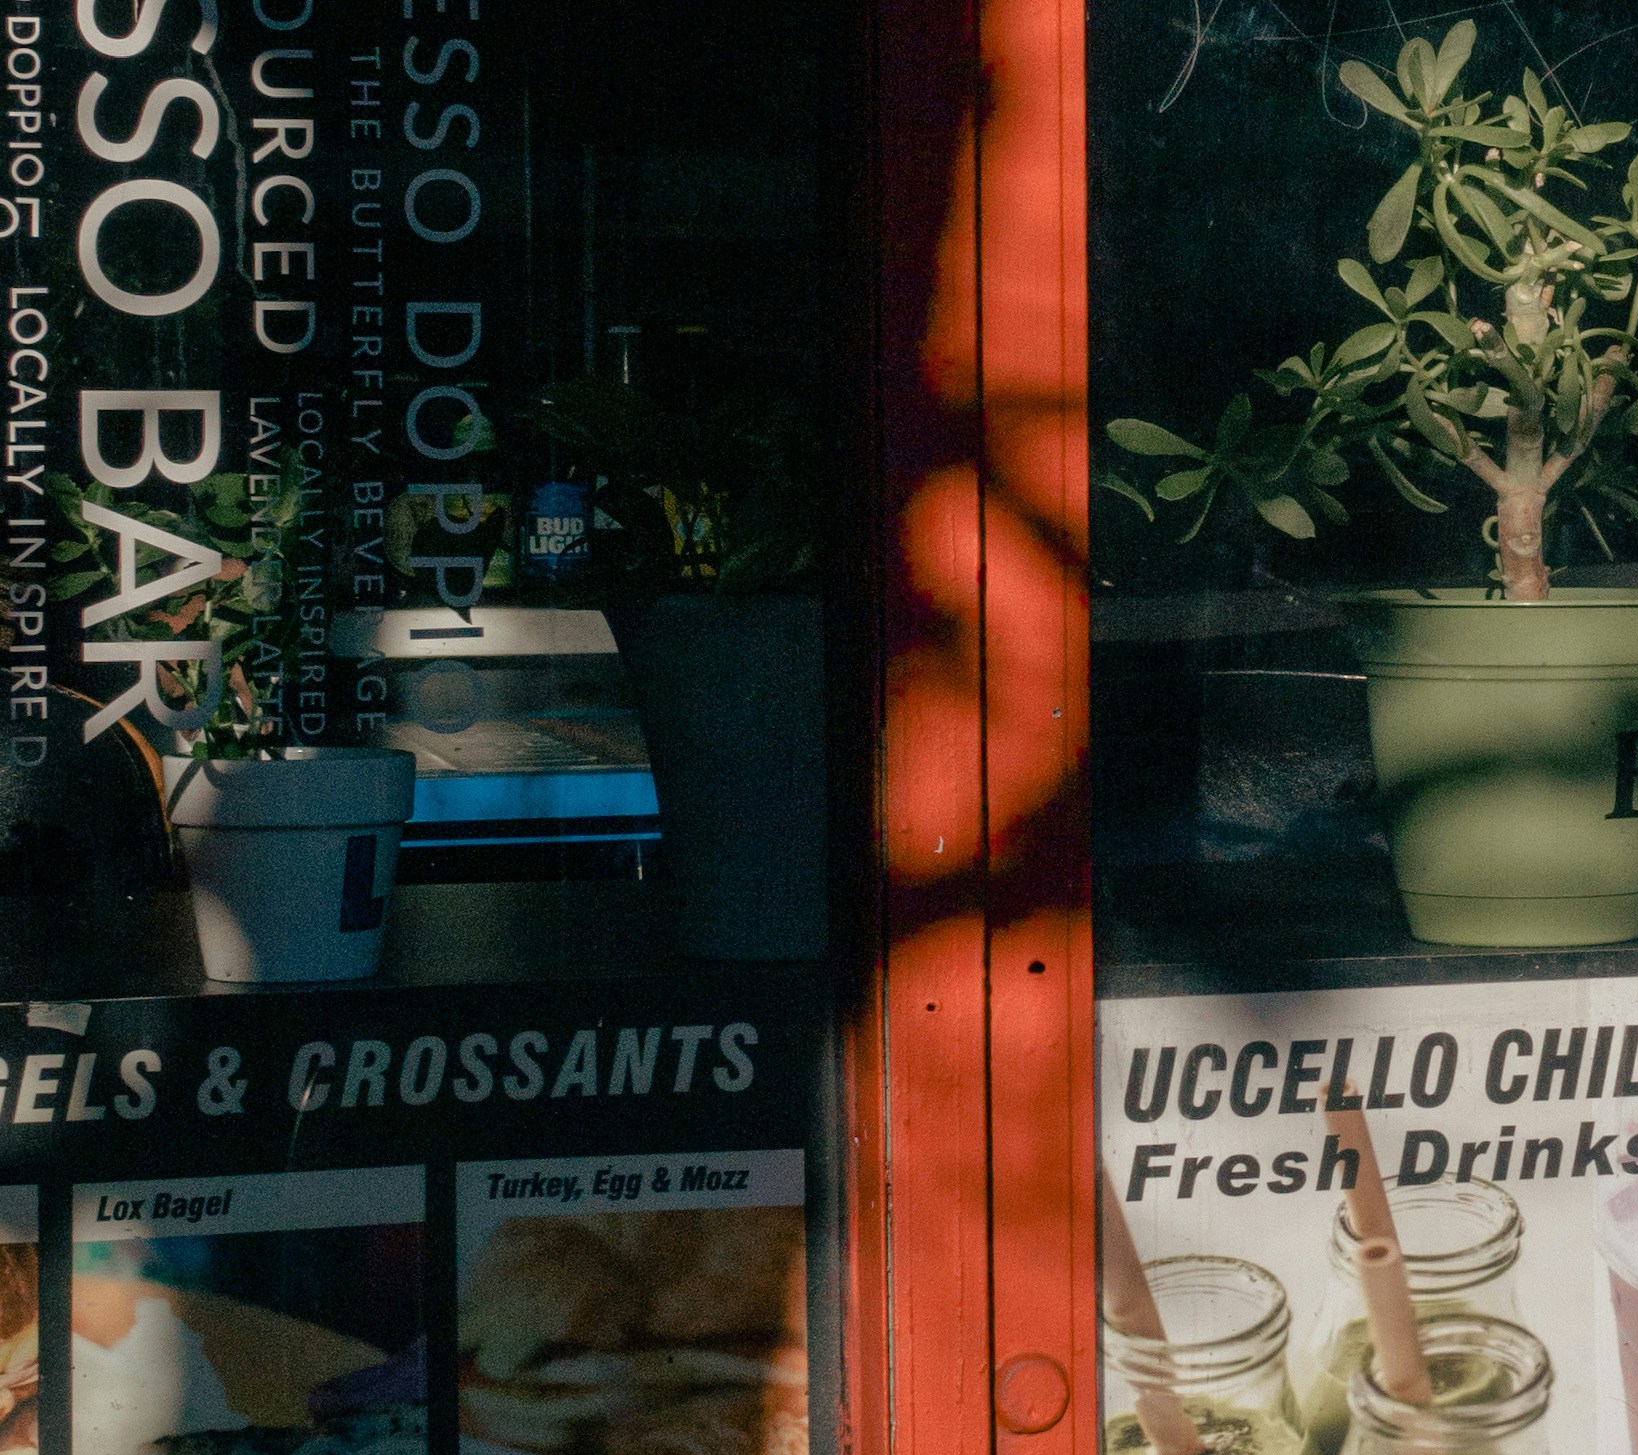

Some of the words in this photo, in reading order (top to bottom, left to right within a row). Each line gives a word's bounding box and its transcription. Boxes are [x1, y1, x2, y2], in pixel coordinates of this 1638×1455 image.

[8, 15, 46, 187] DOPPIO
[350, 46, 382, 139] THE
[351, 168, 385, 455] BUTTERFLY
[7, 286, 50, 495] LOCALLY
[248, 396, 282, 604] LAVENDER
[297, 392, 325, 546] LOCALLY
[405, 301, 485, 735] DOPPIO
[536, 516, 585, 537] BUD
[81, 389, 223, 744] BAR
[7, 518, 49, 768] INSPIRED
[251, 614, 284, 737] LATTE
[297, 565, 326, 735] INSPIRED
[339, 834, 385, 933] L
[0, 1048, 162, 1124] ELS
[195, 1045, 249, 1116] &
[287, 1022, 759, 1113] CROSSANTS
[1123, 1031, 1460, 1124] UCCELLO
[96, 1194, 145, 1223] Lox
[152, 1188, 234, 1223] Bagel
[486, 1171, 583, 1203] Turkey,
[592, 1168, 642, 1200] Egg
[651, 1166, 670, 1193] &
[680, 1164, 751, 1192] Mozz
[1125, 1134, 1363, 1203] Fresh
